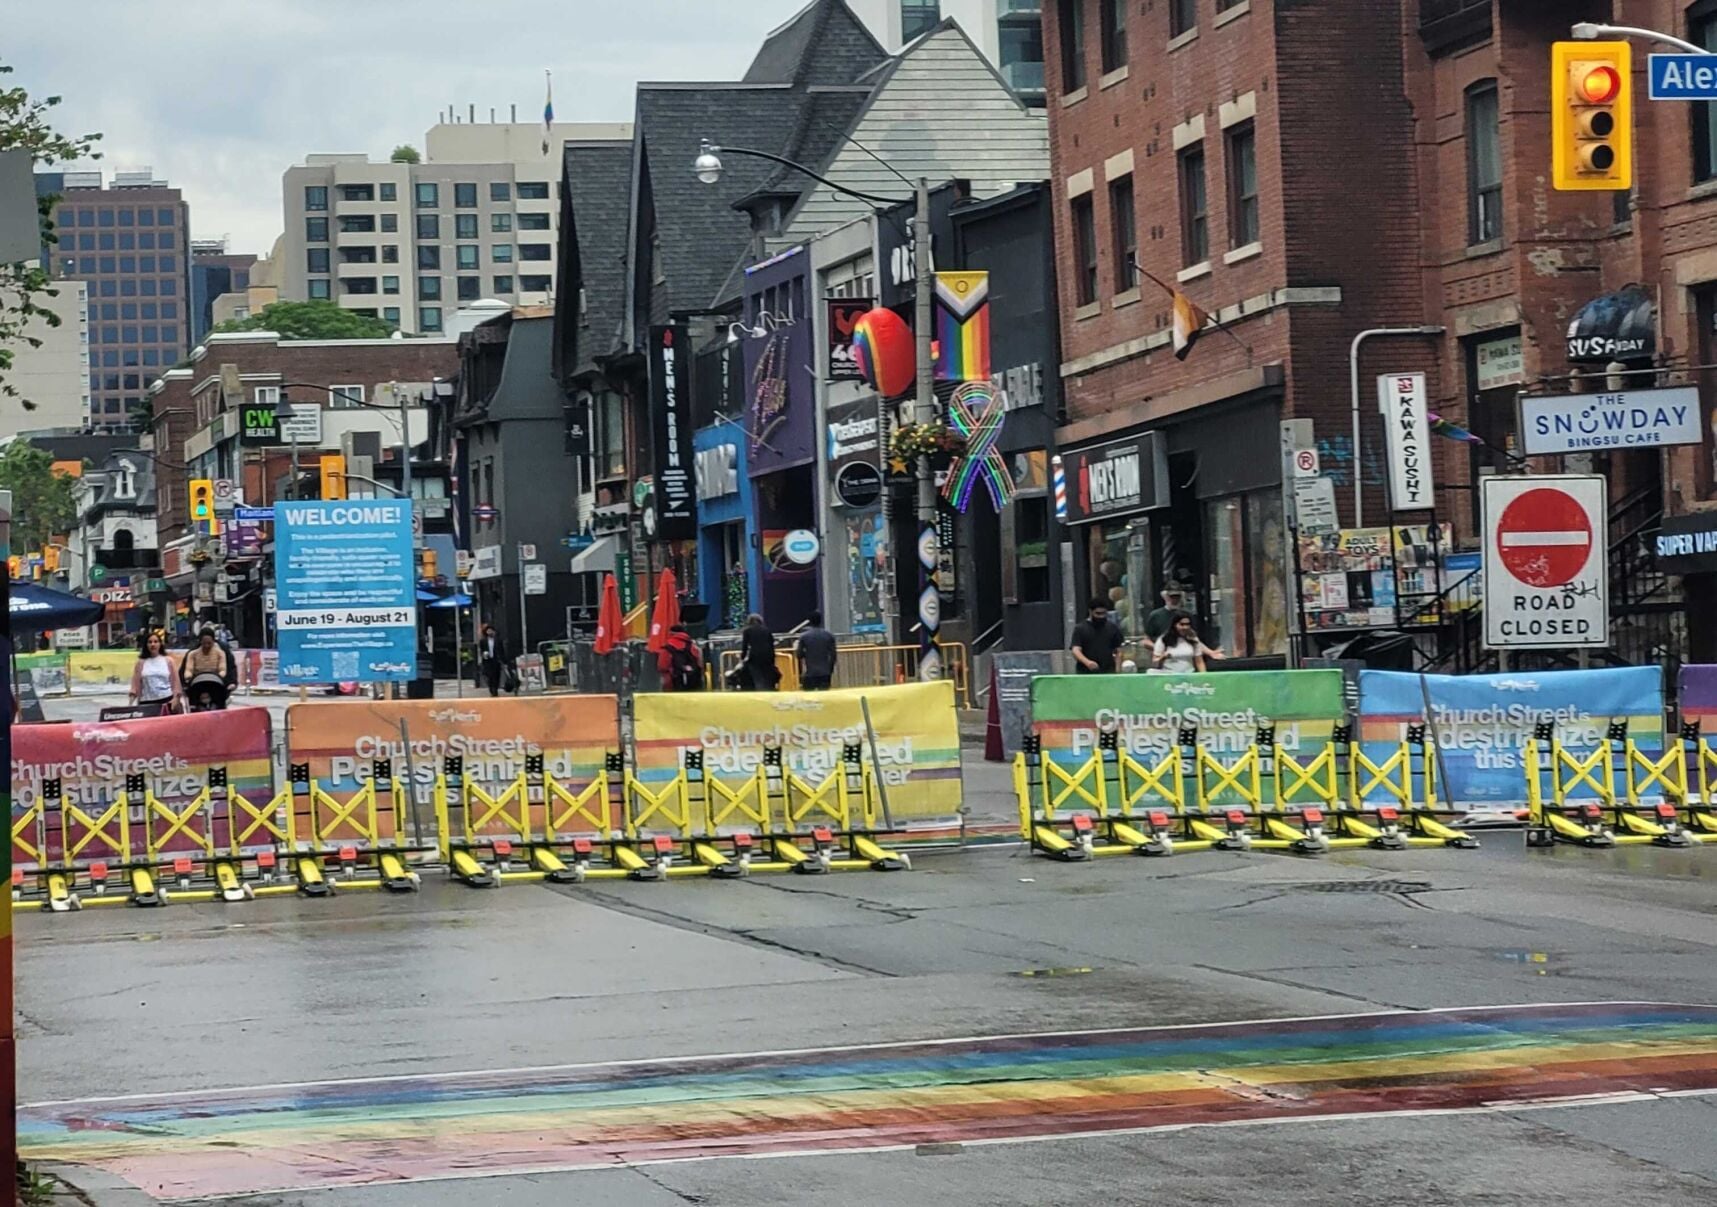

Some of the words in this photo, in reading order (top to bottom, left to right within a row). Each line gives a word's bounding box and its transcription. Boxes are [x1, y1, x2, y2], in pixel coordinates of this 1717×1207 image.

[1662, 61, 1717, 89] Ale
[1596, 395, 1625, 405] THE
[1400, 397, 1416, 441] KAWA
[1536, 406, 1687, 435] SNOWDAY
[1568, 435, 1620, 448] BINGSU
[1625, 433, 1660, 444] CAFE
[1403, 445, 1420, 502] SUSHI
[285, 507, 401, 526] WELCOME!
[1345, 536, 1378, 545] ADULT
[1346, 545, 1380, 557] TOYS
[1656, 534, 1694, 556] SUPER
[1514, 596, 1576, 610] ROAD
[285, 614, 317, 625] June
[320, 613, 335, 624] 19
[345, 612, 391, 626] August
[394, 612, 409, 622] 21
[1501, 619, 1589, 635] CLOSED
[1095, 707, 1182, 731] Church
[1183, 706, 1256, 729] Street
[1508, 703, 1577, 725] Street
[355, 735, 446, 759] Church
[448, 734, 526, 757] Street
[700, 723, 792, 748] Church
[94, 752, 172, 780] Street
[175, 757, 189, 770] is
[1474, 750, 1515, 769] this
